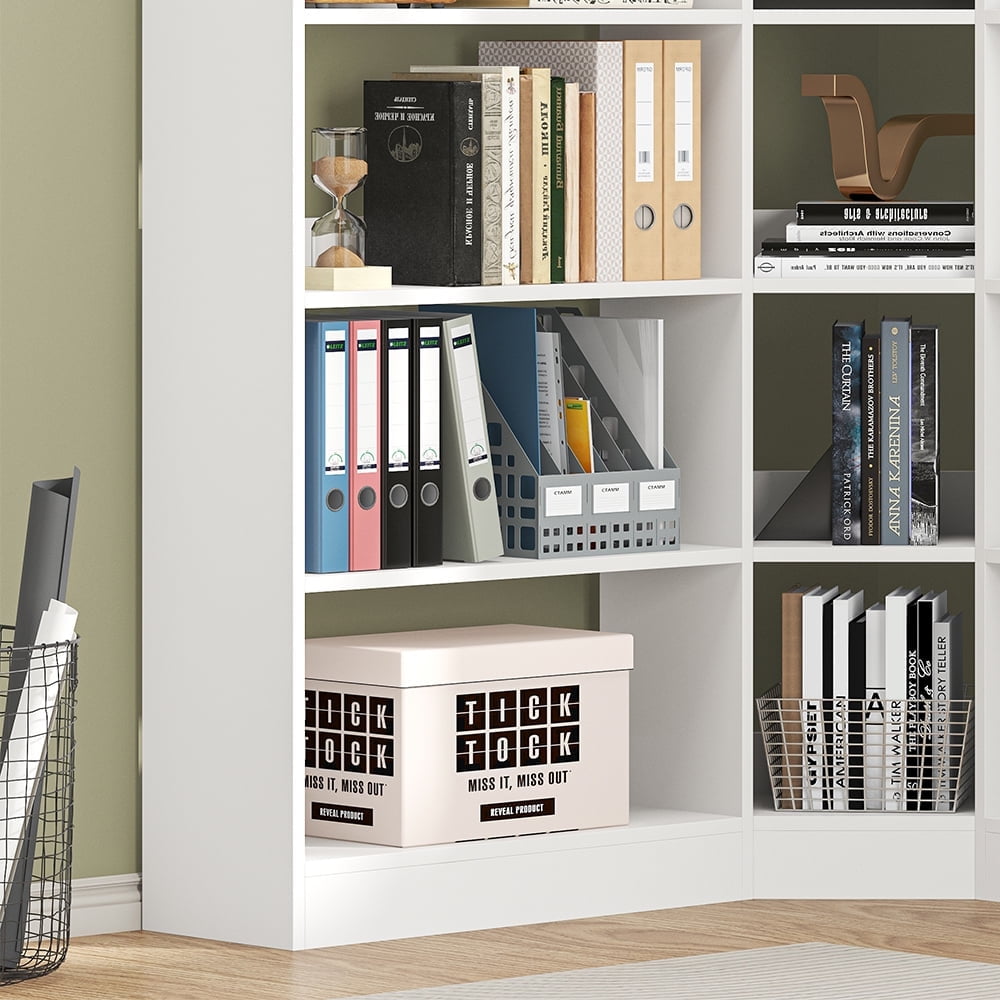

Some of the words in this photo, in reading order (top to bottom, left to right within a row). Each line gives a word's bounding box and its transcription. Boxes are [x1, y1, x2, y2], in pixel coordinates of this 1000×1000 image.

[842, 341, 852, 363] THE
[842, 364, 852, 411] CURTAIN
[888, 395, 900, 482] KARENINA
[843, 473, 851, 514] PATRICK
[888, 486, 900, 536] ANNA
[843, 520, 852, 540] ORD
[909, 650, 918, 679] BOOK
[918, 659, 932, 678] Co
[938, 636, 946, 674] TELLER
[305, 696, 386, 729] ICK
[465, 692, 572, 726] TICK
[909, 681, 918, 728] PLAYBOY
[938, 678, 946, 714] STORY
[806, 701, 818, 786] GYPSET
[836, 696, 846, 788] AMERICAN
[891, 700, 902, 756] WALKER
[909, 731, 918, 752] THE
[305, 736, 386, 768] OCK
[465, 732, 572, 766] TOCK
[327, 778, 338, 792] IT,
[342, 779, 364, 794] MISS
[368, 782, 384, 796] OUT
[468, 777, 496, 792] MISS
[500, 776, 512, 791] IT,
[516, 772, 544, 788] MISS
[548, 770, 568, 786] OUT
[891, 762, 902, 786] TIM
[320, 807, 339, 818] REVEAL
[340, 810, 364, 820] PRODUCT
[490, 805, 514, 816] REVEAL
[516, 804, 544, 815] PRODUCT
